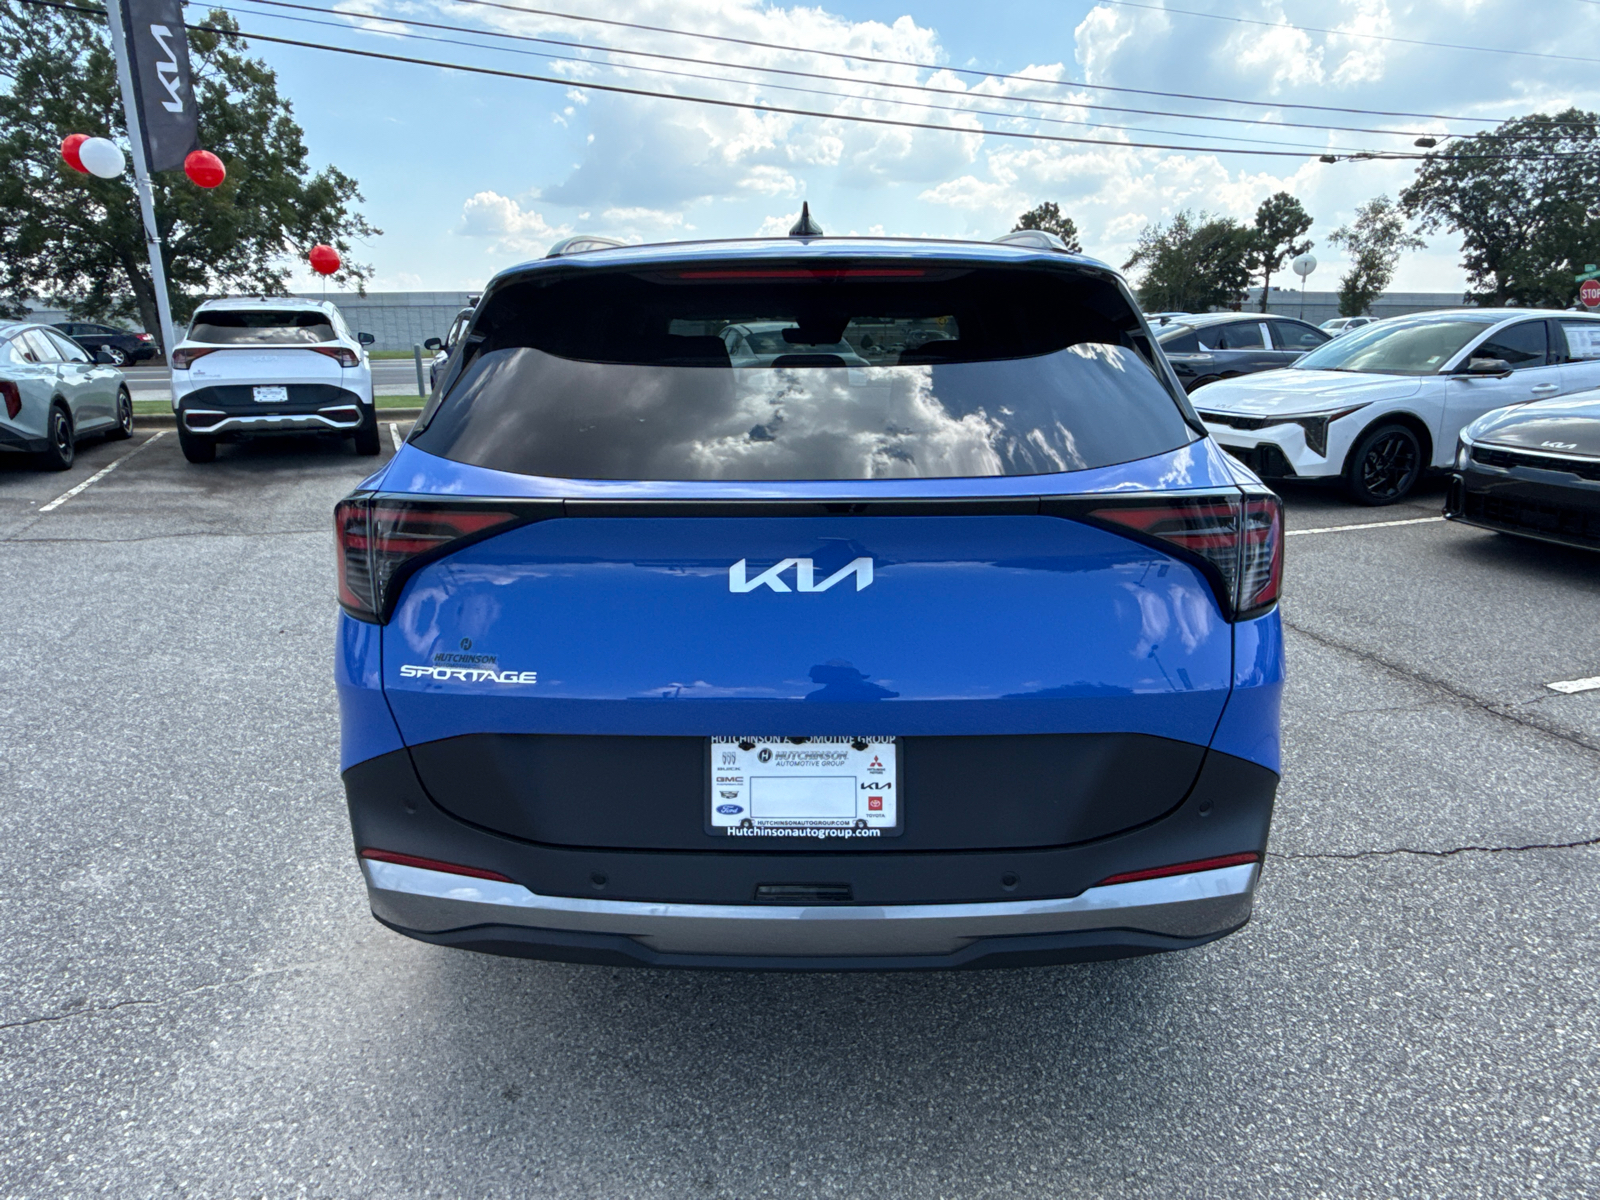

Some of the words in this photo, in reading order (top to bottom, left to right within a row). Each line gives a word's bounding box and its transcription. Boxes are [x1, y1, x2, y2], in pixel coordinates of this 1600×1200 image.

[150, 24, 183, 112] KIA
[1540, 440, 1577, 449] KIA
[729, 557, 873, 593] KIA
[434, 653, 497, 664] HUTCHINSON
[400, 664, 537, 684] SPORTAGE
[774, 751, 849, 760] HUTCHINSON
[860, 782, 892, 790] KIA
[727, 827, 881, 839] Hutchinsonautogroup.com
